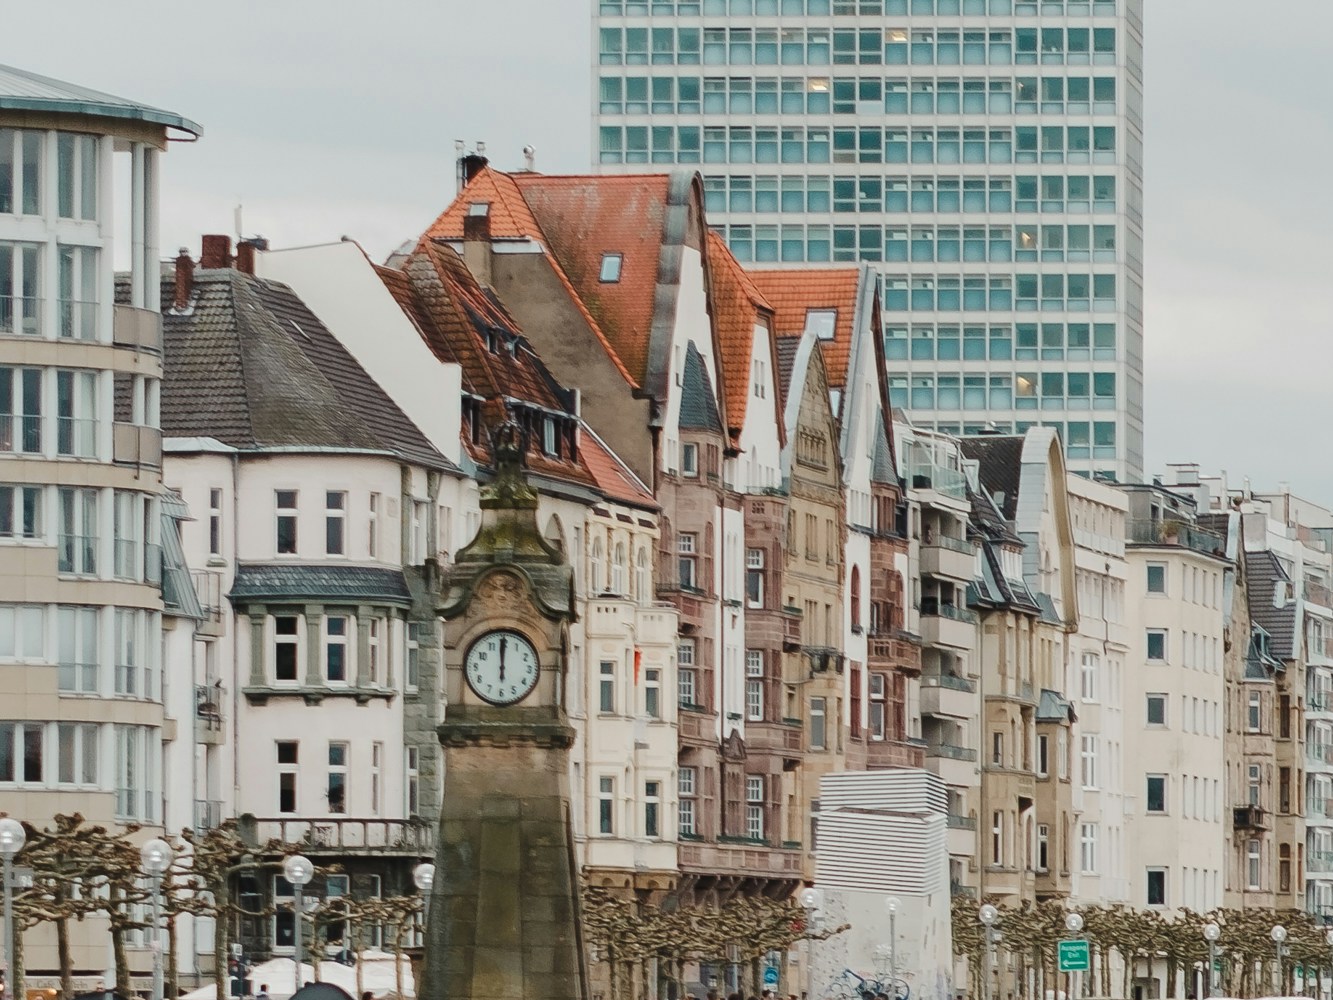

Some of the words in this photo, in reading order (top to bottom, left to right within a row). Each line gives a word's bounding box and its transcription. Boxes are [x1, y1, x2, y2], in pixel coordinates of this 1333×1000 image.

[488, 642, 496, 651] 11
[478, 652, 487, 661] 10
[523, 652, 528, 662] 2
[527, 665, 532, 674] 3
[521, 677, 527, 685] 4
[487, 684, 492, 693] 7
[499, 688, 504, 697] 6
[511, 685, 517, 694] 5
